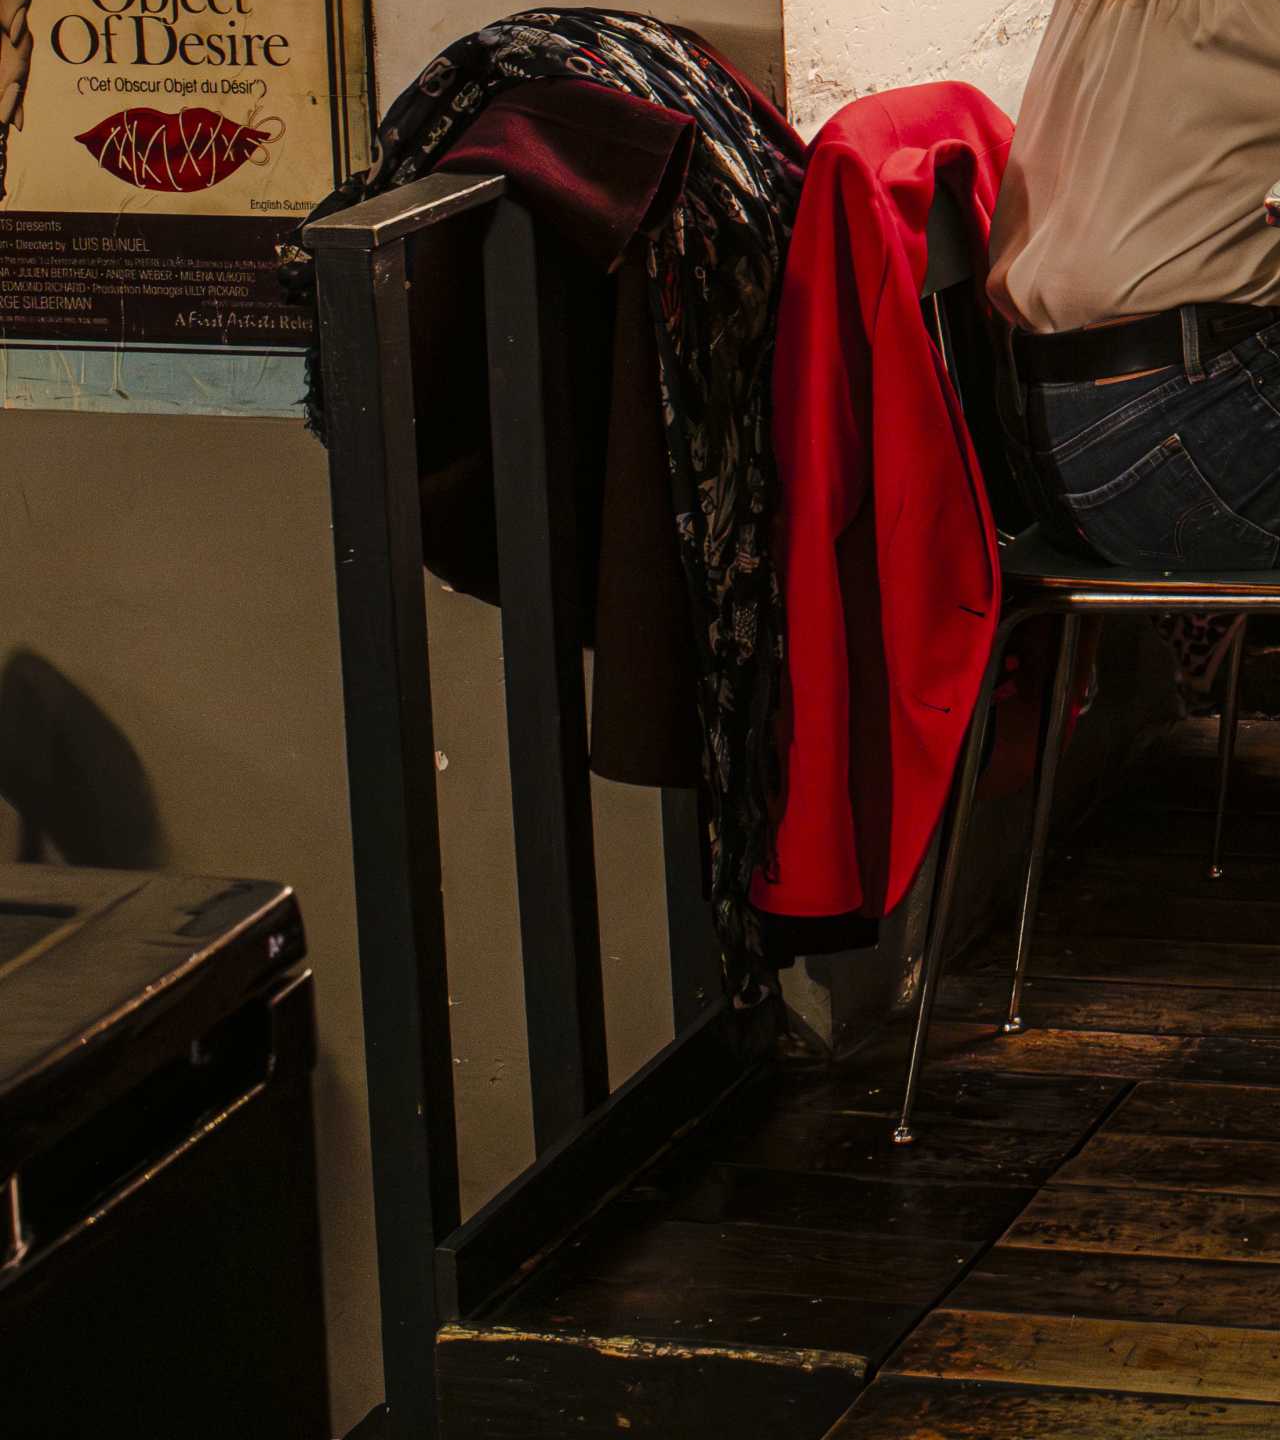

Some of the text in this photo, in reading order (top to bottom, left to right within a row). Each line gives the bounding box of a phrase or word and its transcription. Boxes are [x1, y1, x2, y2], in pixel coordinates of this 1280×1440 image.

[50, 14, 291, 67] Of Desire
[114, 78, 163, 94] Obscur
[164, 78, 197, 96] Objet
[200, 79, 218, 94] du
[250, 199, 281, 212] English
[16, 240, 53, 250] Directed
[55, 240, 65, 253] by
[72, 237, 98, 252] LUIS
[22, 296, 92, 311] SILBERMAN
[175, 312, 186, 327] A
